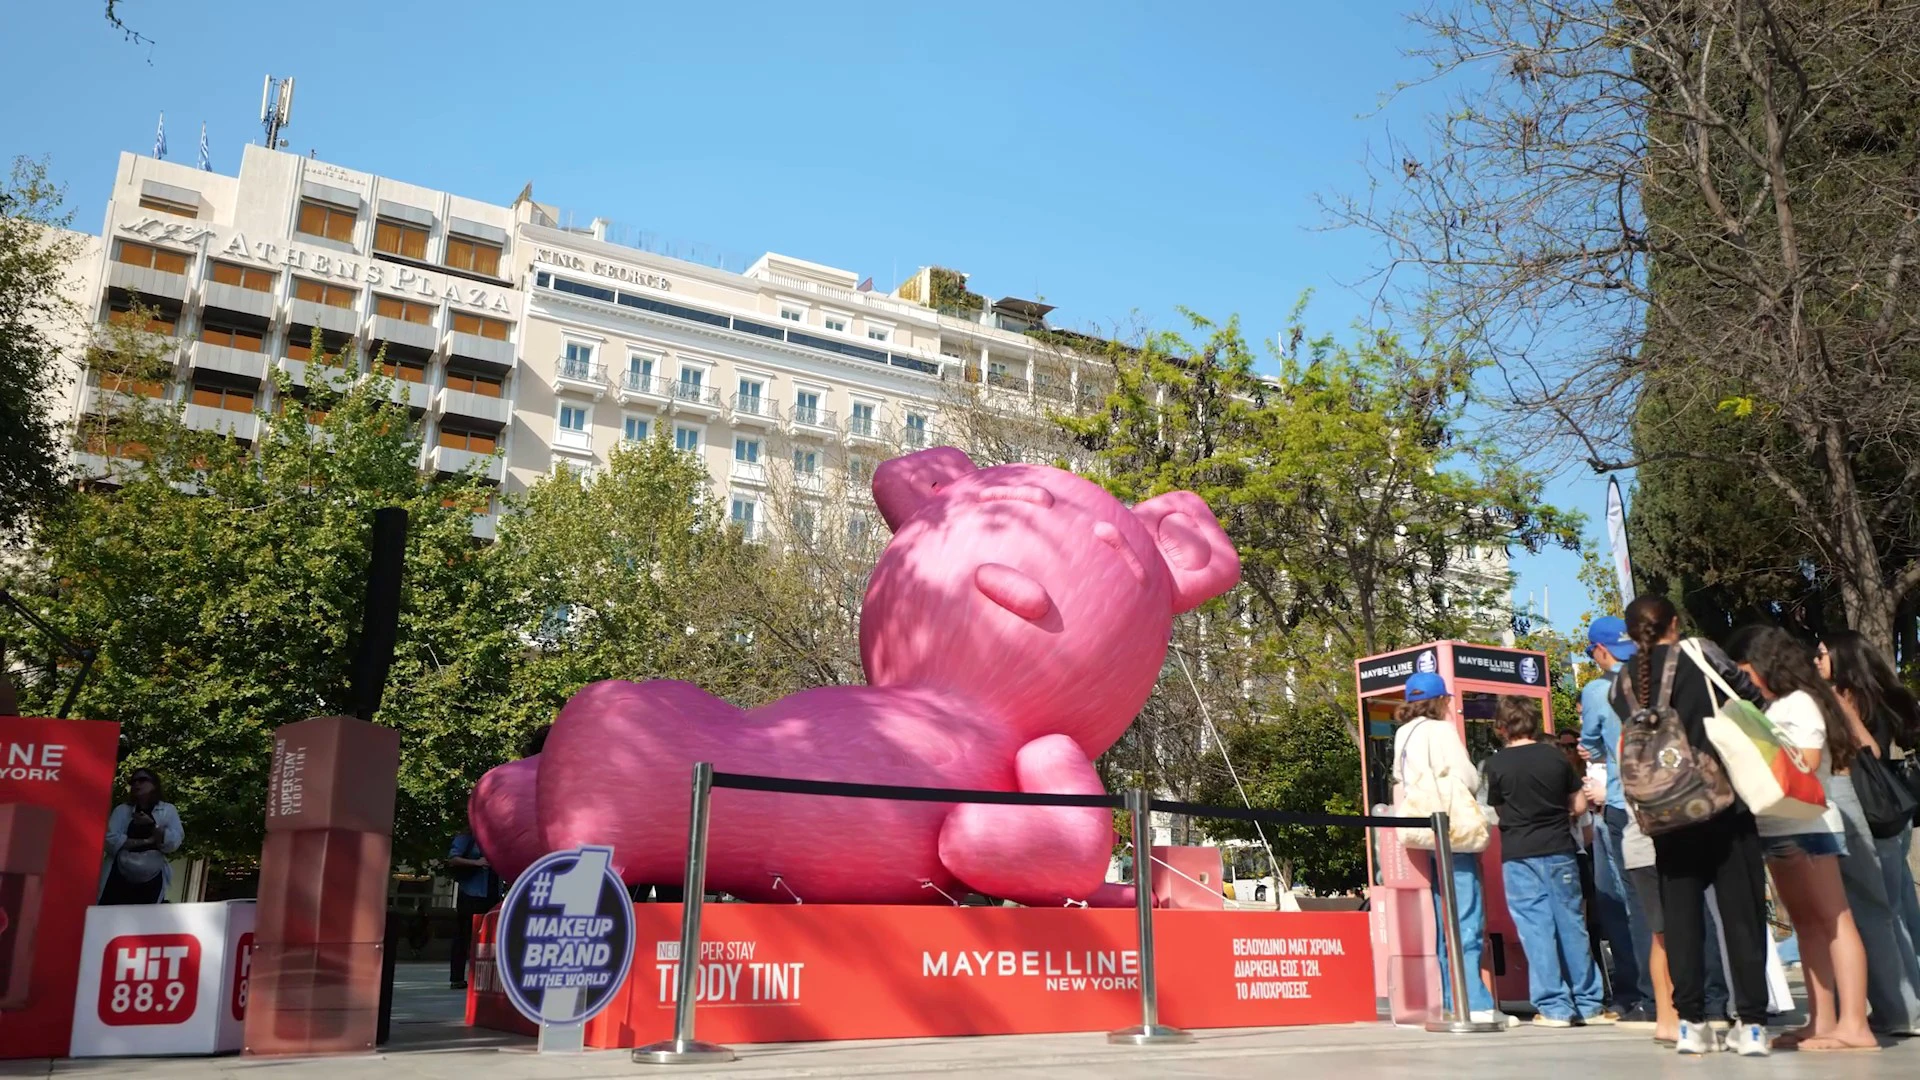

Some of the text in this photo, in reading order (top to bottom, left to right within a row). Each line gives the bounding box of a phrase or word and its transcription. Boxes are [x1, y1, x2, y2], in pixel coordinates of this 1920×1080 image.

[223, 231, 384, 286] ATHENS
[390, 265, 511, 314] PLAZA
[535, 248, 672, 291] KING GEORGE
[1361, 661, 1413, 680] MAYBELLINE
[1458, 656, 1515, 669] MAYBELLINE
[0, 767, 60, 781] YORK
[281, 752, 296, 816] SUPER STAY
[293, 747, 307, 814] TEDDY TINT
[530, 850, 610, 917] #1
[526, 917, 613, 937] MAKEUP
[523, 943, 610, 967] BRAND
[700, 941, 756, 960] PER STAY
[1233, 938, 1286, 956] ΒΕΛΟΥΔΙΝΟ
[115, 946, 189, 981] HiT
[922, 951, 1138, 976] MAYBELLINE
[1234, 960, 1280, 977] ΔΙΑΡΚΕΙΑ
[1280, 960, 1299, 977] ΕΩΣ
[523, 974, 538, 987] IN
[539, 973, 564, 987] THE
[749, 963, 804, 1000] TINT
[1046, 976, 1138, 991] NEW YORK
[1236, 982, 1248, 1000] 10
[111, 981, 185, 1013] 88.9
